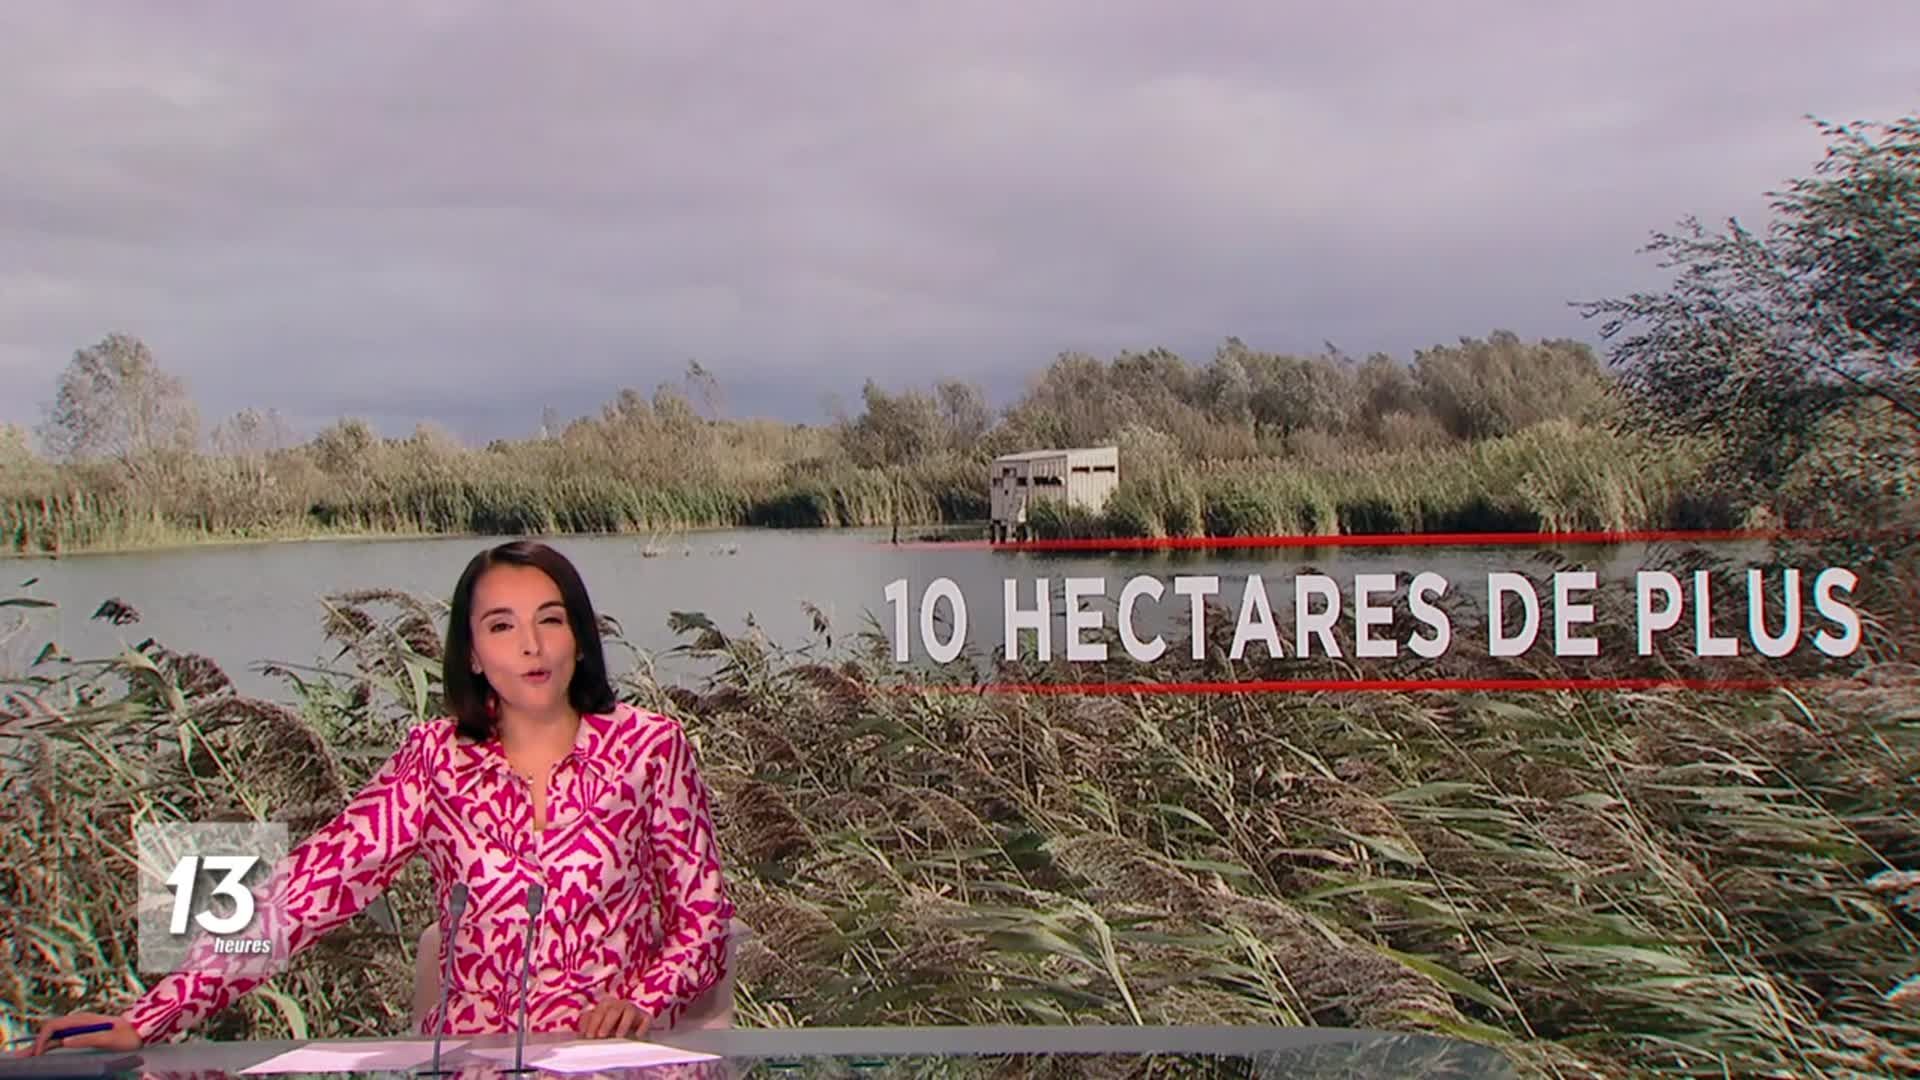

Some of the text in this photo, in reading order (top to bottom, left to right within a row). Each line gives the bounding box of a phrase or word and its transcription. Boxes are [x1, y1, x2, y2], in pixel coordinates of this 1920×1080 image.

[883, 567, 1863, 664] 10 HECTARES DE PLUS
